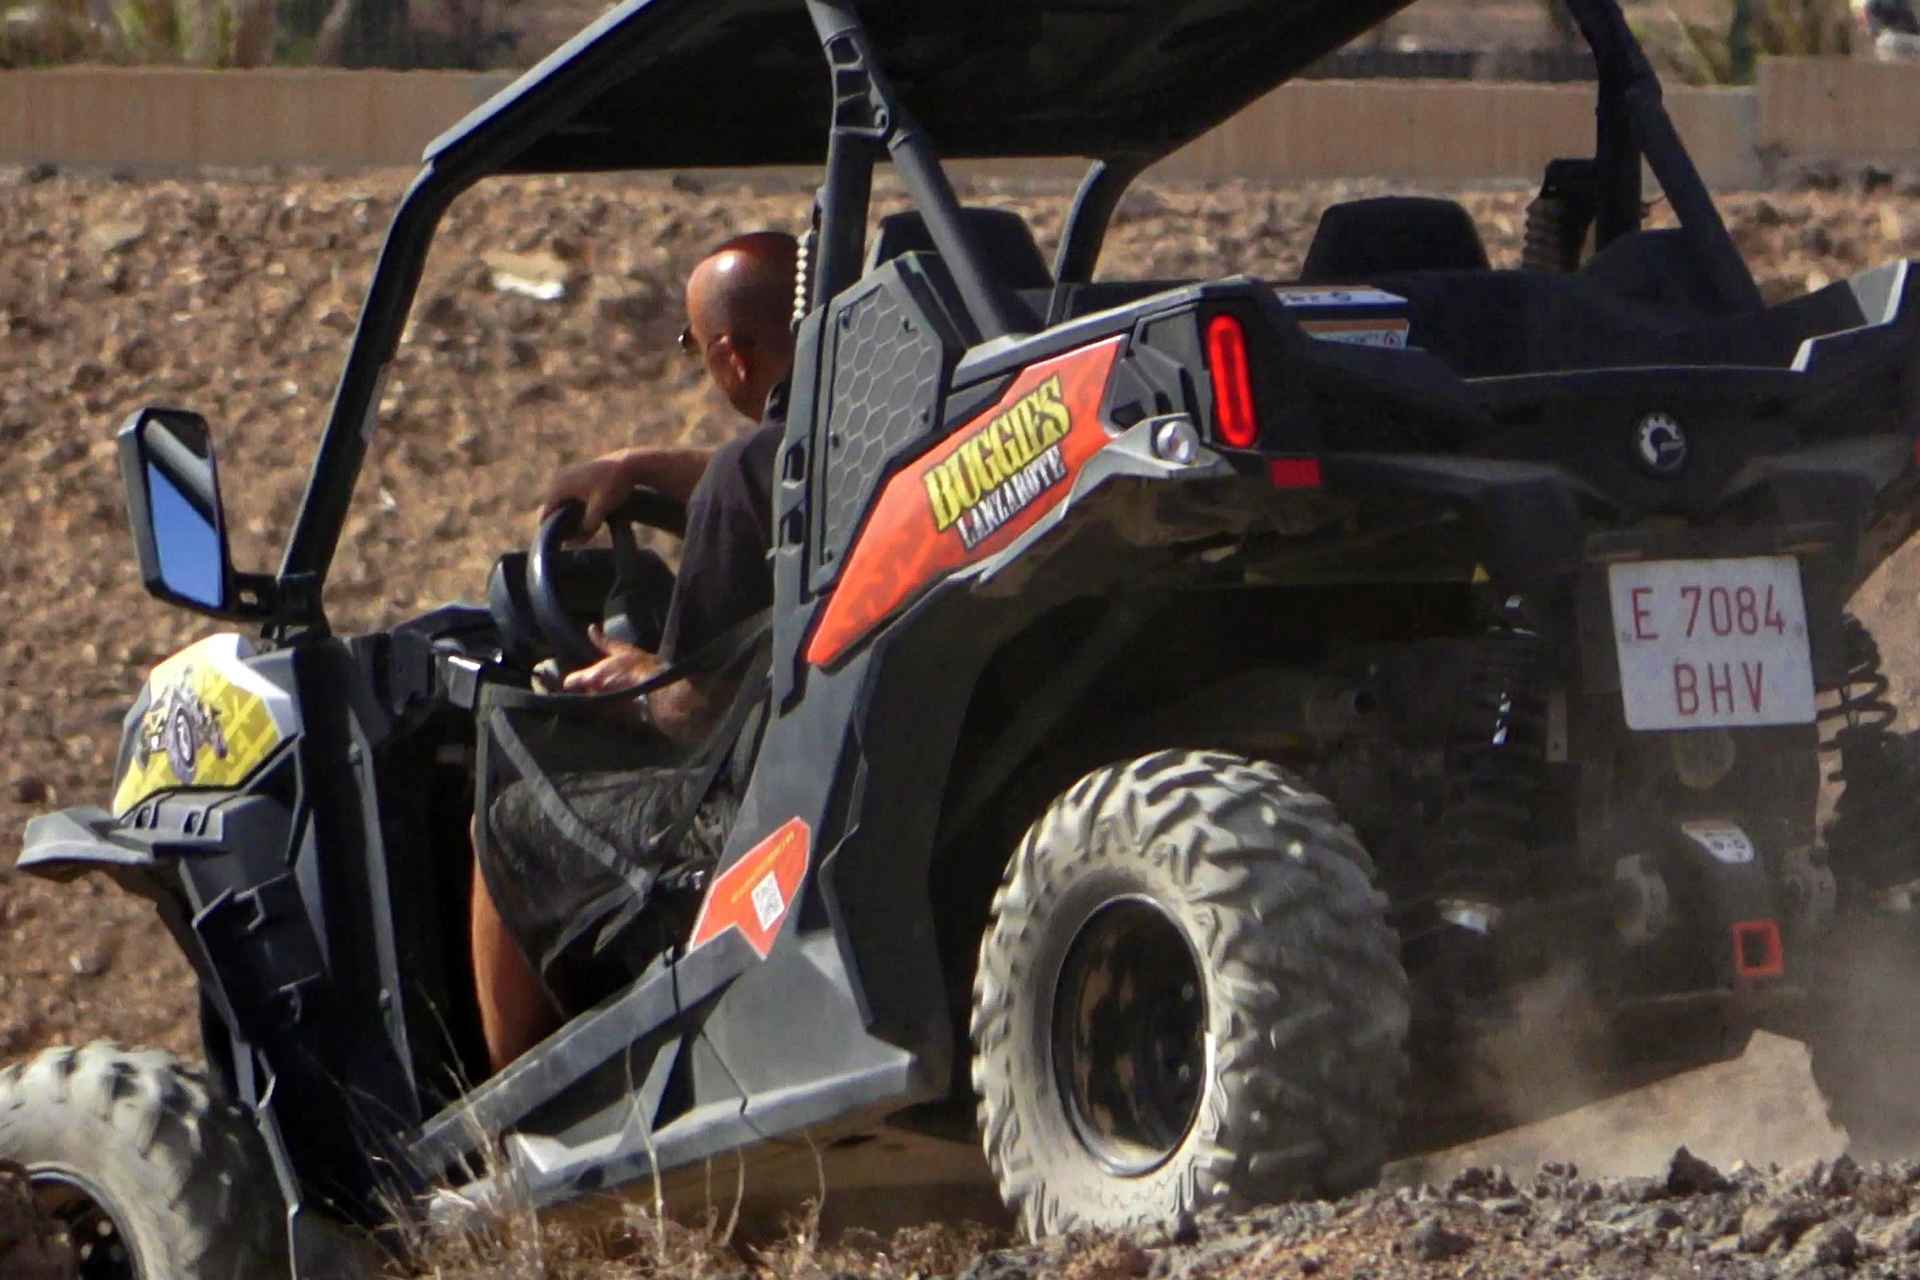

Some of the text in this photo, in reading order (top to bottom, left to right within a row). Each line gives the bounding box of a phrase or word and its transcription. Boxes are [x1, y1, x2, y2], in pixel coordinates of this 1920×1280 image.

[1631, 584, 1786, 640] E 7084
[1673, 661, 1763, 716] BHV
